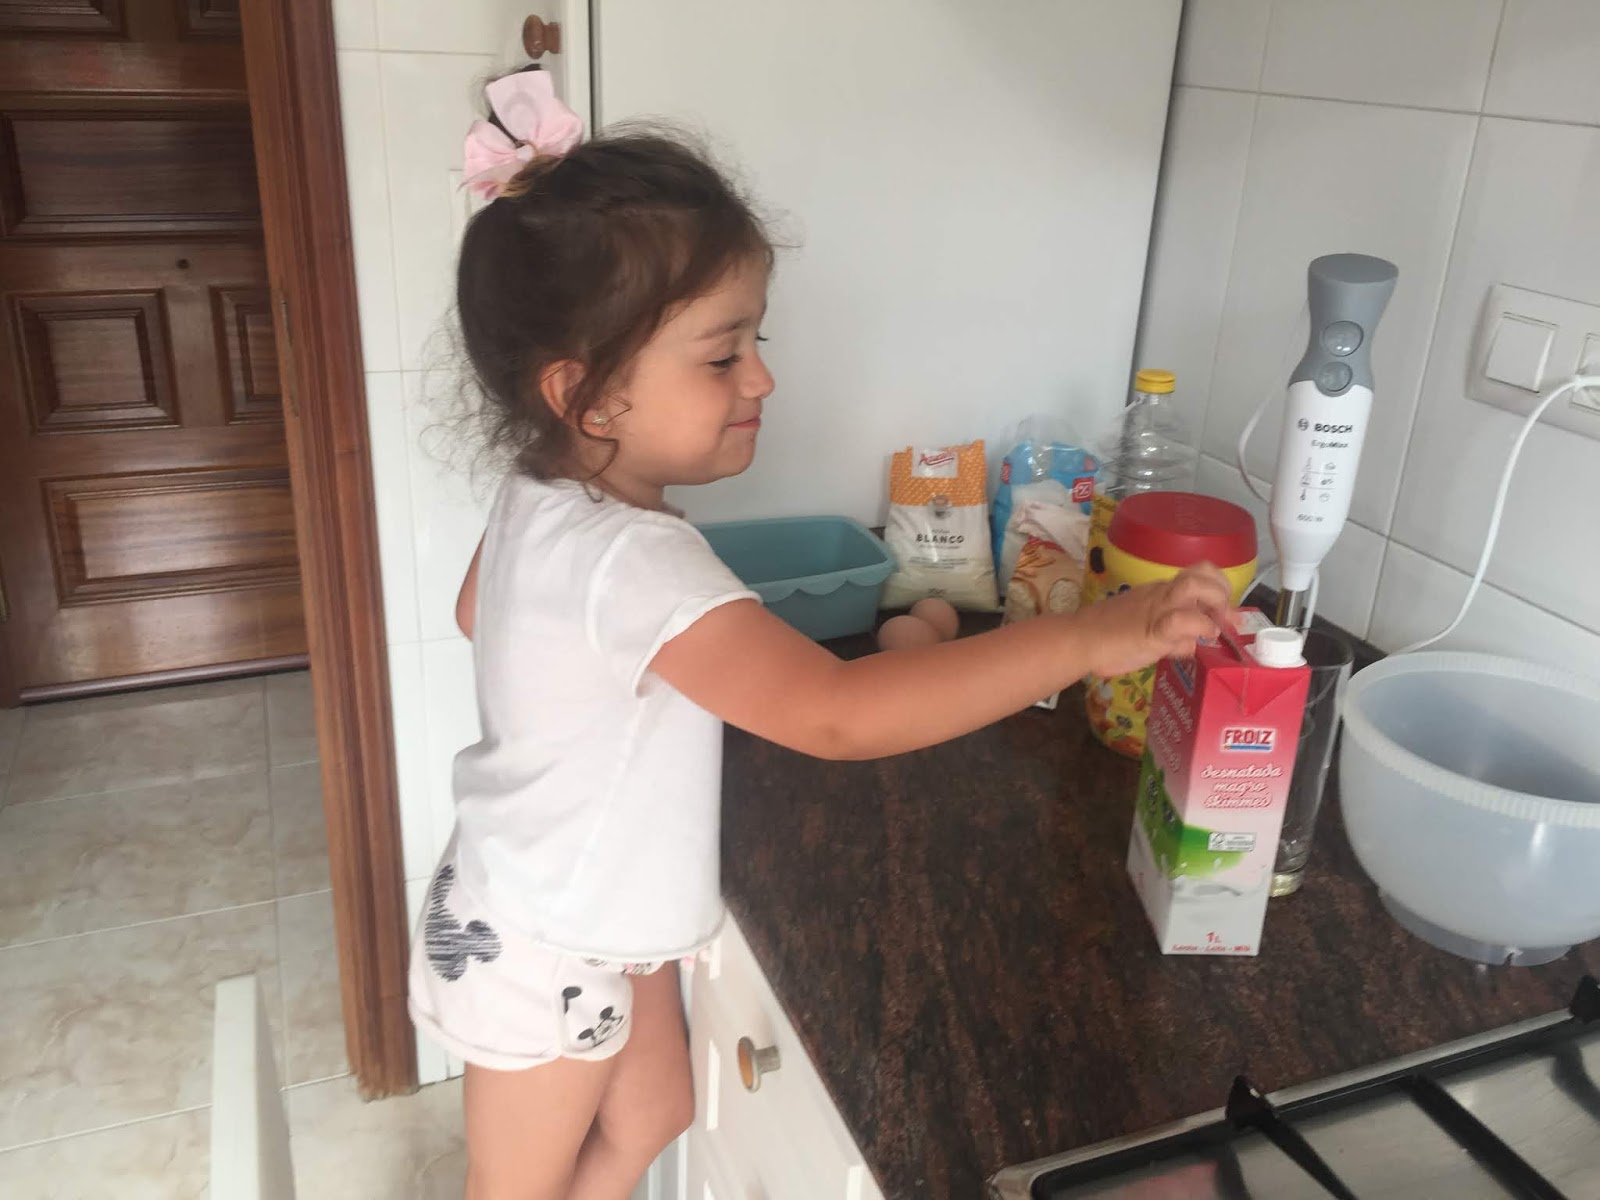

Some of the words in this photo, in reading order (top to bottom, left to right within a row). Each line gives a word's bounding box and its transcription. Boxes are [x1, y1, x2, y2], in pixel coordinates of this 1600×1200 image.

[1314, 423, 1353, 433] BOSCH
[916, 533, 964, 543] BLANCO
[1224, 729, 1273, 745] FROIZ
[1201, 764, 1283, 779] desnatada
